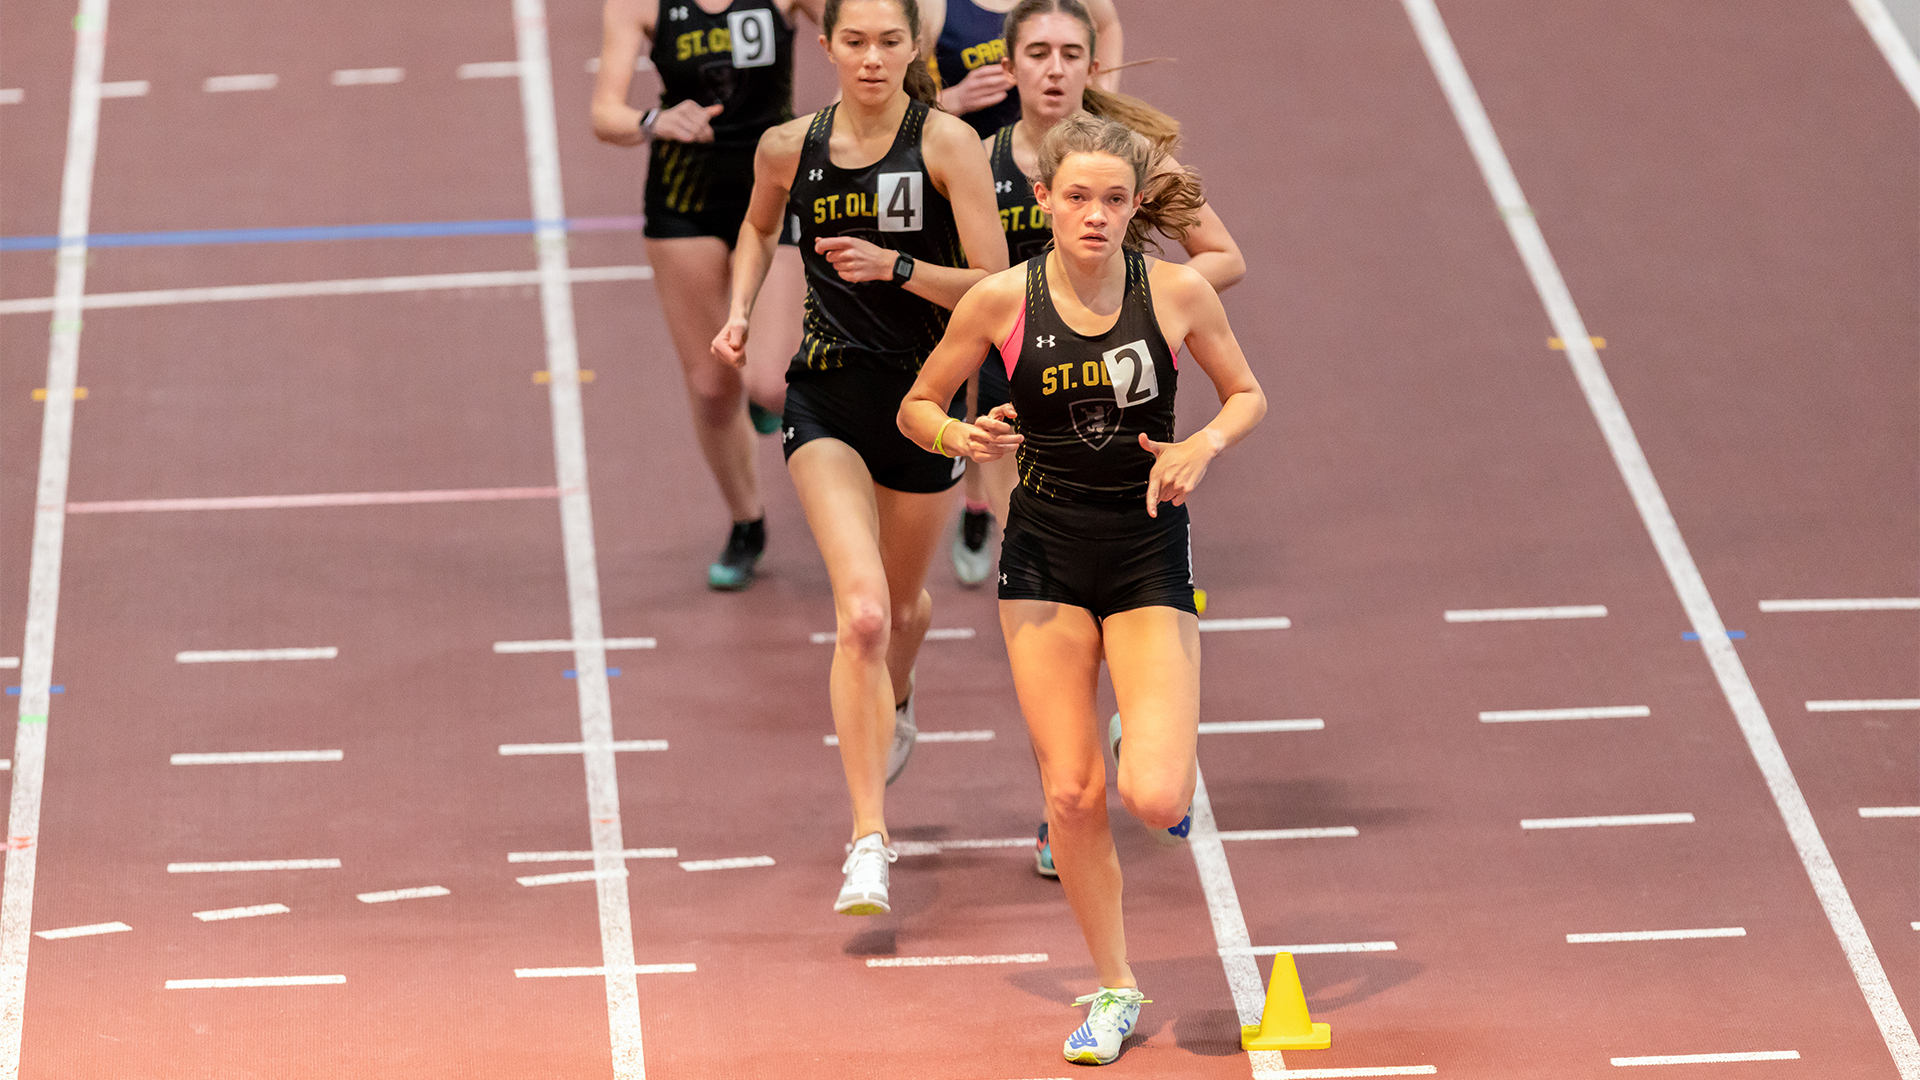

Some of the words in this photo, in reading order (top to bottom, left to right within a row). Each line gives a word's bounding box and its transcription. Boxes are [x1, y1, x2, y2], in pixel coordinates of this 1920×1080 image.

[742, 16, 763, 60] 9
[961, 38, 1007, 70] CAR
[813, 194, 842, 224] ST.
[887, 176, 916, 228] 4
[1042, 362, 1077, 396] ST.
[1114, 347, 1151, 404] 2
